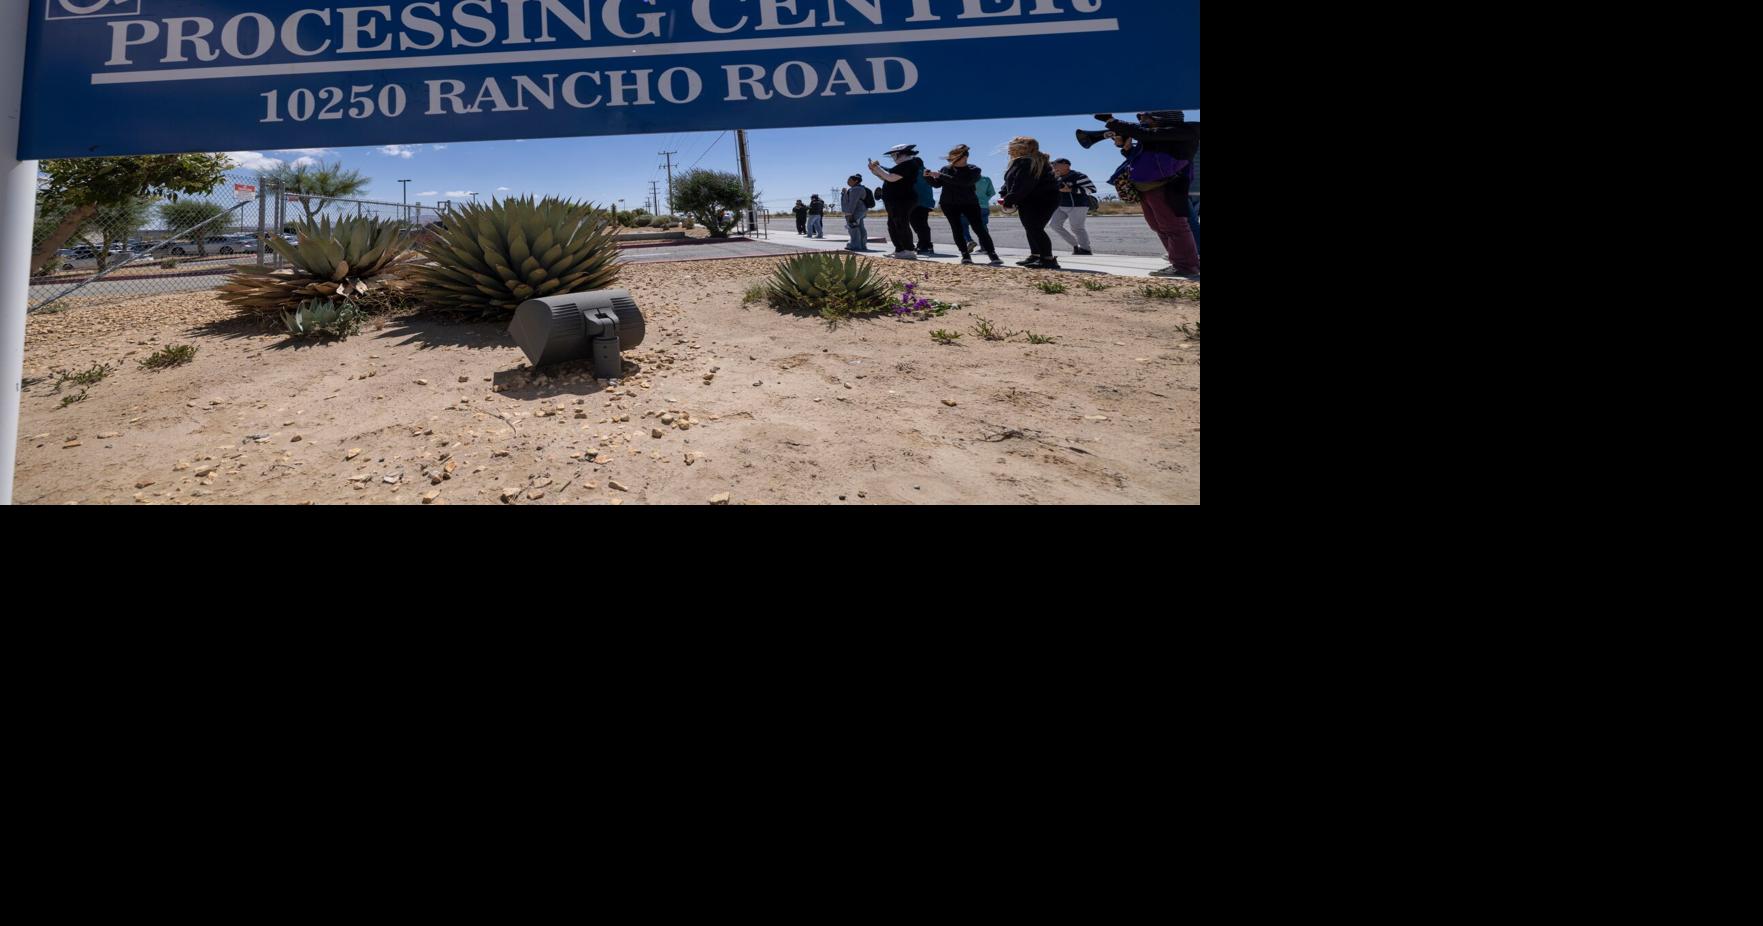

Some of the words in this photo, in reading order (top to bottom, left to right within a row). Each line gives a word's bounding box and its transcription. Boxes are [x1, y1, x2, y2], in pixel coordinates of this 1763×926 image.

[104, 0, 666, 66] PROCESSING
[259, 84, 406, 123] 10250
[424, 66, 703, 116] RANCHO
[722, 56, 919, 101] ROAD
